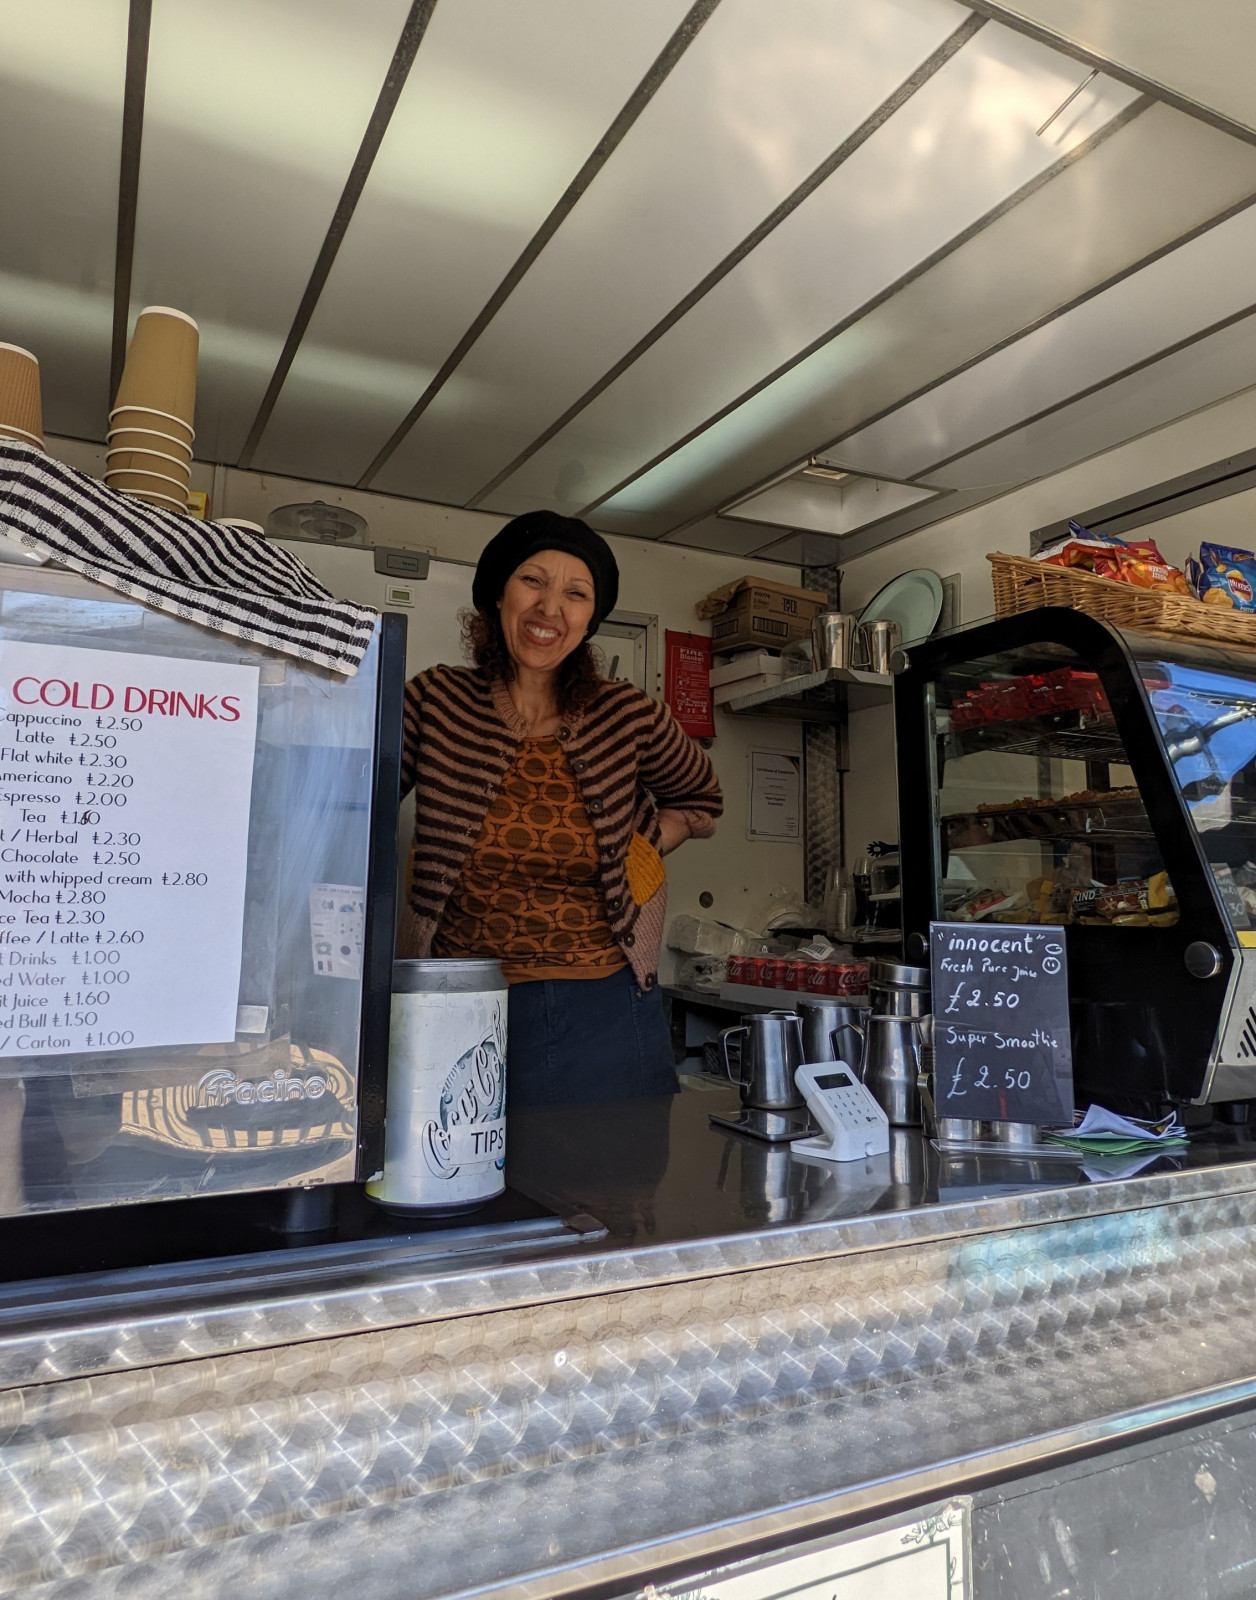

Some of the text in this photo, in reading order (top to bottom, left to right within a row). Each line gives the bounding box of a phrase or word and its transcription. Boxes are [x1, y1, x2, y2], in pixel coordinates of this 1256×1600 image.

[12, 676, 241, 722] COLD DRINKS
[95, 715, 143, 732] £2.50
[16, 729, 117, 749] Latte £2.50
[1, 748, 127, 769] Flat white £2.30
[0, 770, 134, 789] mericano £2.20
[75, 791, 127, 807] £2.00
[20, 808, 46, 823] Tea
[26, 829, 78, 844] Herbal
[91, 831, 141, 847] £2.30
[1, 848, 141, 866] Chocolate £2.50
[5, 869, 208, 889] with whipped cream £2.80
[0, 889, 106, 905] Mocha £2.80
[1072, 890, 1096, 902] KIND
[0, 909, 105, 925] ce Tea £2.30
[0, 930, 31, 944] ffee
[51, 930, 90, 944] Latte
[95, 930, 144, 945] £2.60
[9, 951, 57, 966] Drinks
[72, 950, 120, 965] £1.00
[940, 957, 974, 974] Fresh
[981, 959, 1008, 974] Pure
[18, 972, 67, 986] Water
[81, 970, 130, 985] £1.00
[11, 993, 48, 1012] Juice
[63, 991, 110, 1006] £1.60
[19, 1013, 47, 1028] Bull
[52, 1011, 98, 1027] £1.50
[16, 1034, 71, 1049] Carton
[85, 1030, 134, 1047] £1.00
[946, 1026, 1058, 1049] Super Smoothie
[470, 1127, 504, 1155] TIPS
